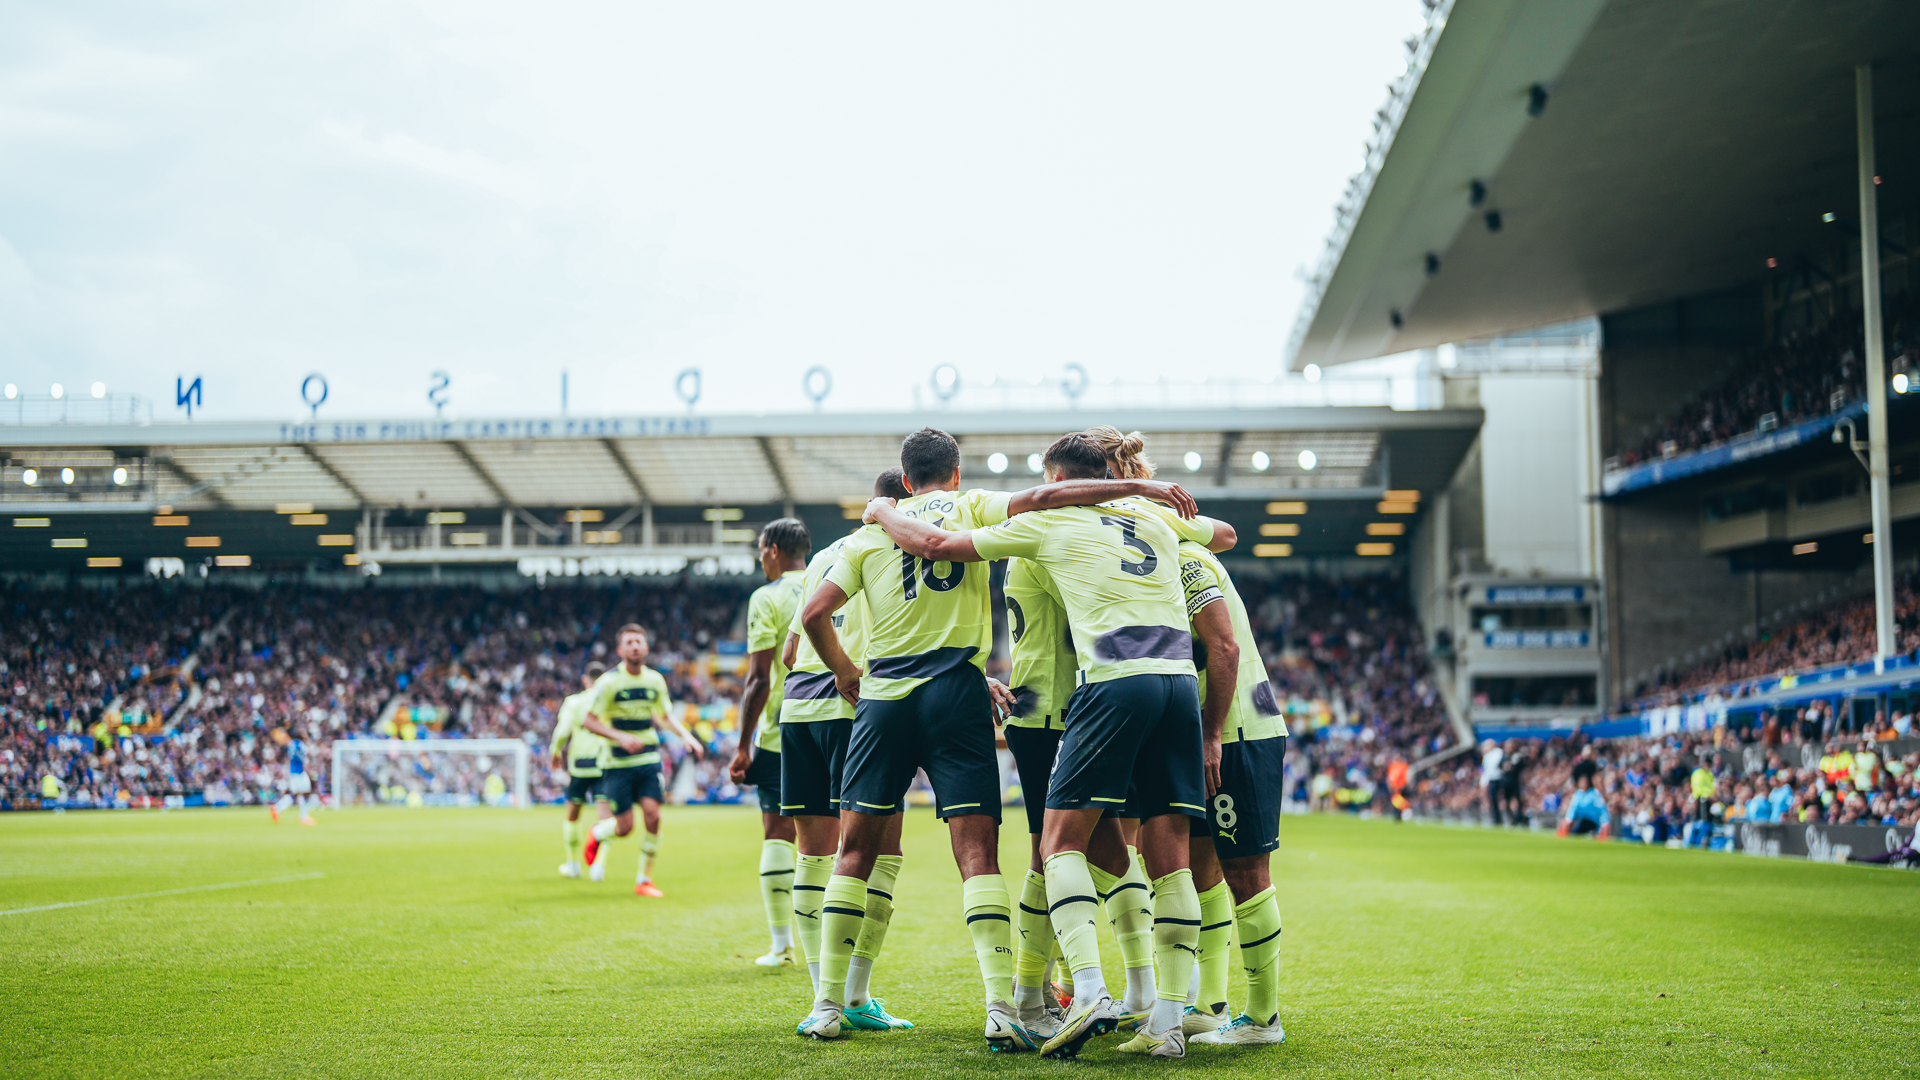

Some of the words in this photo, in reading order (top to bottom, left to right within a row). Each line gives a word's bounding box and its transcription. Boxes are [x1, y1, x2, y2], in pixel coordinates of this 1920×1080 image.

[279, 425, 319, 442] THE
[333, 424, 367, 442] SIR
[380, 423, 451, 441] PHILIP
[1100, 516, 1158, 576] 3
[1180, 560, 1203, 574] XEN
[1187, 591, 1212, 612] aptain
[1213, 793, 1237, 829] 8
